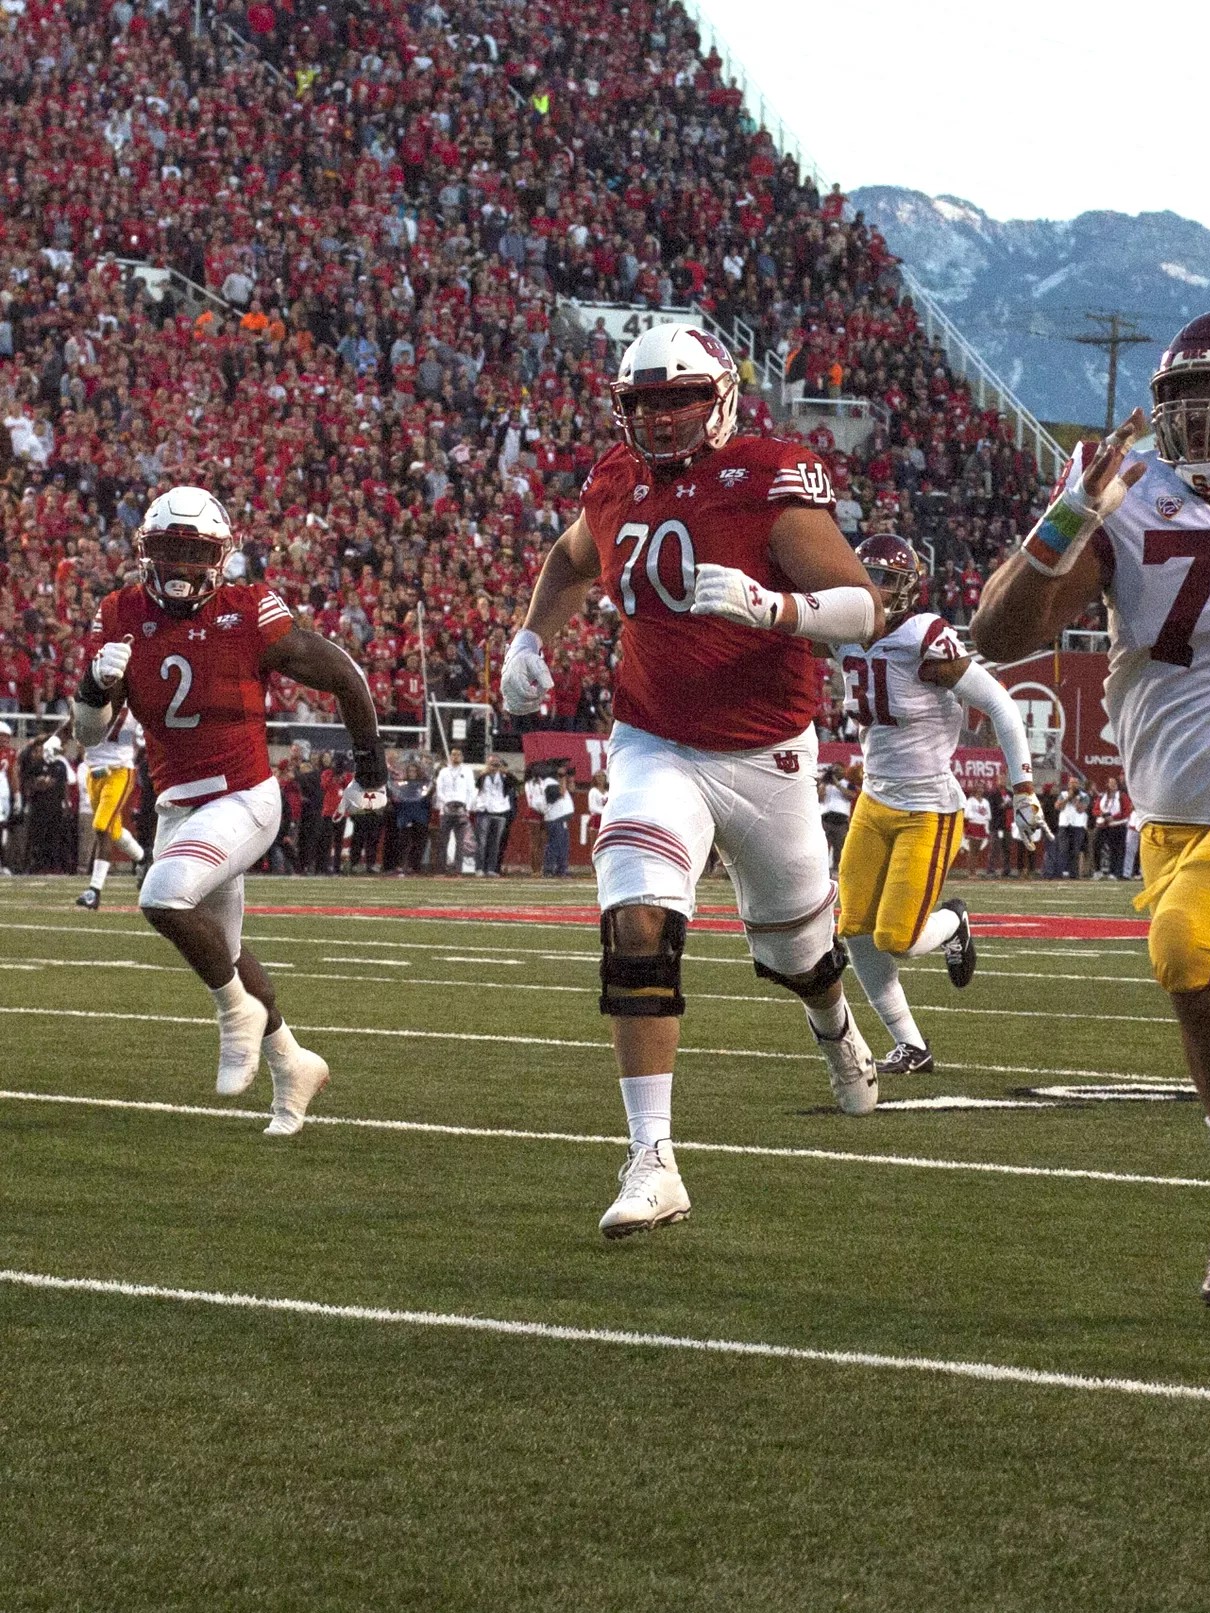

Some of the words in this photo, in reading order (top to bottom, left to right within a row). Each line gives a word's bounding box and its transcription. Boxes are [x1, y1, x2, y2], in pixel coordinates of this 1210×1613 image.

[615, 519, 696, 616] 70
[160, 654, 201, 728] 2
[843, 654, 898, 727] 31
[965, 760, 1002, 777] FIRST
[1084, 754, 1122, 765] UNDE
